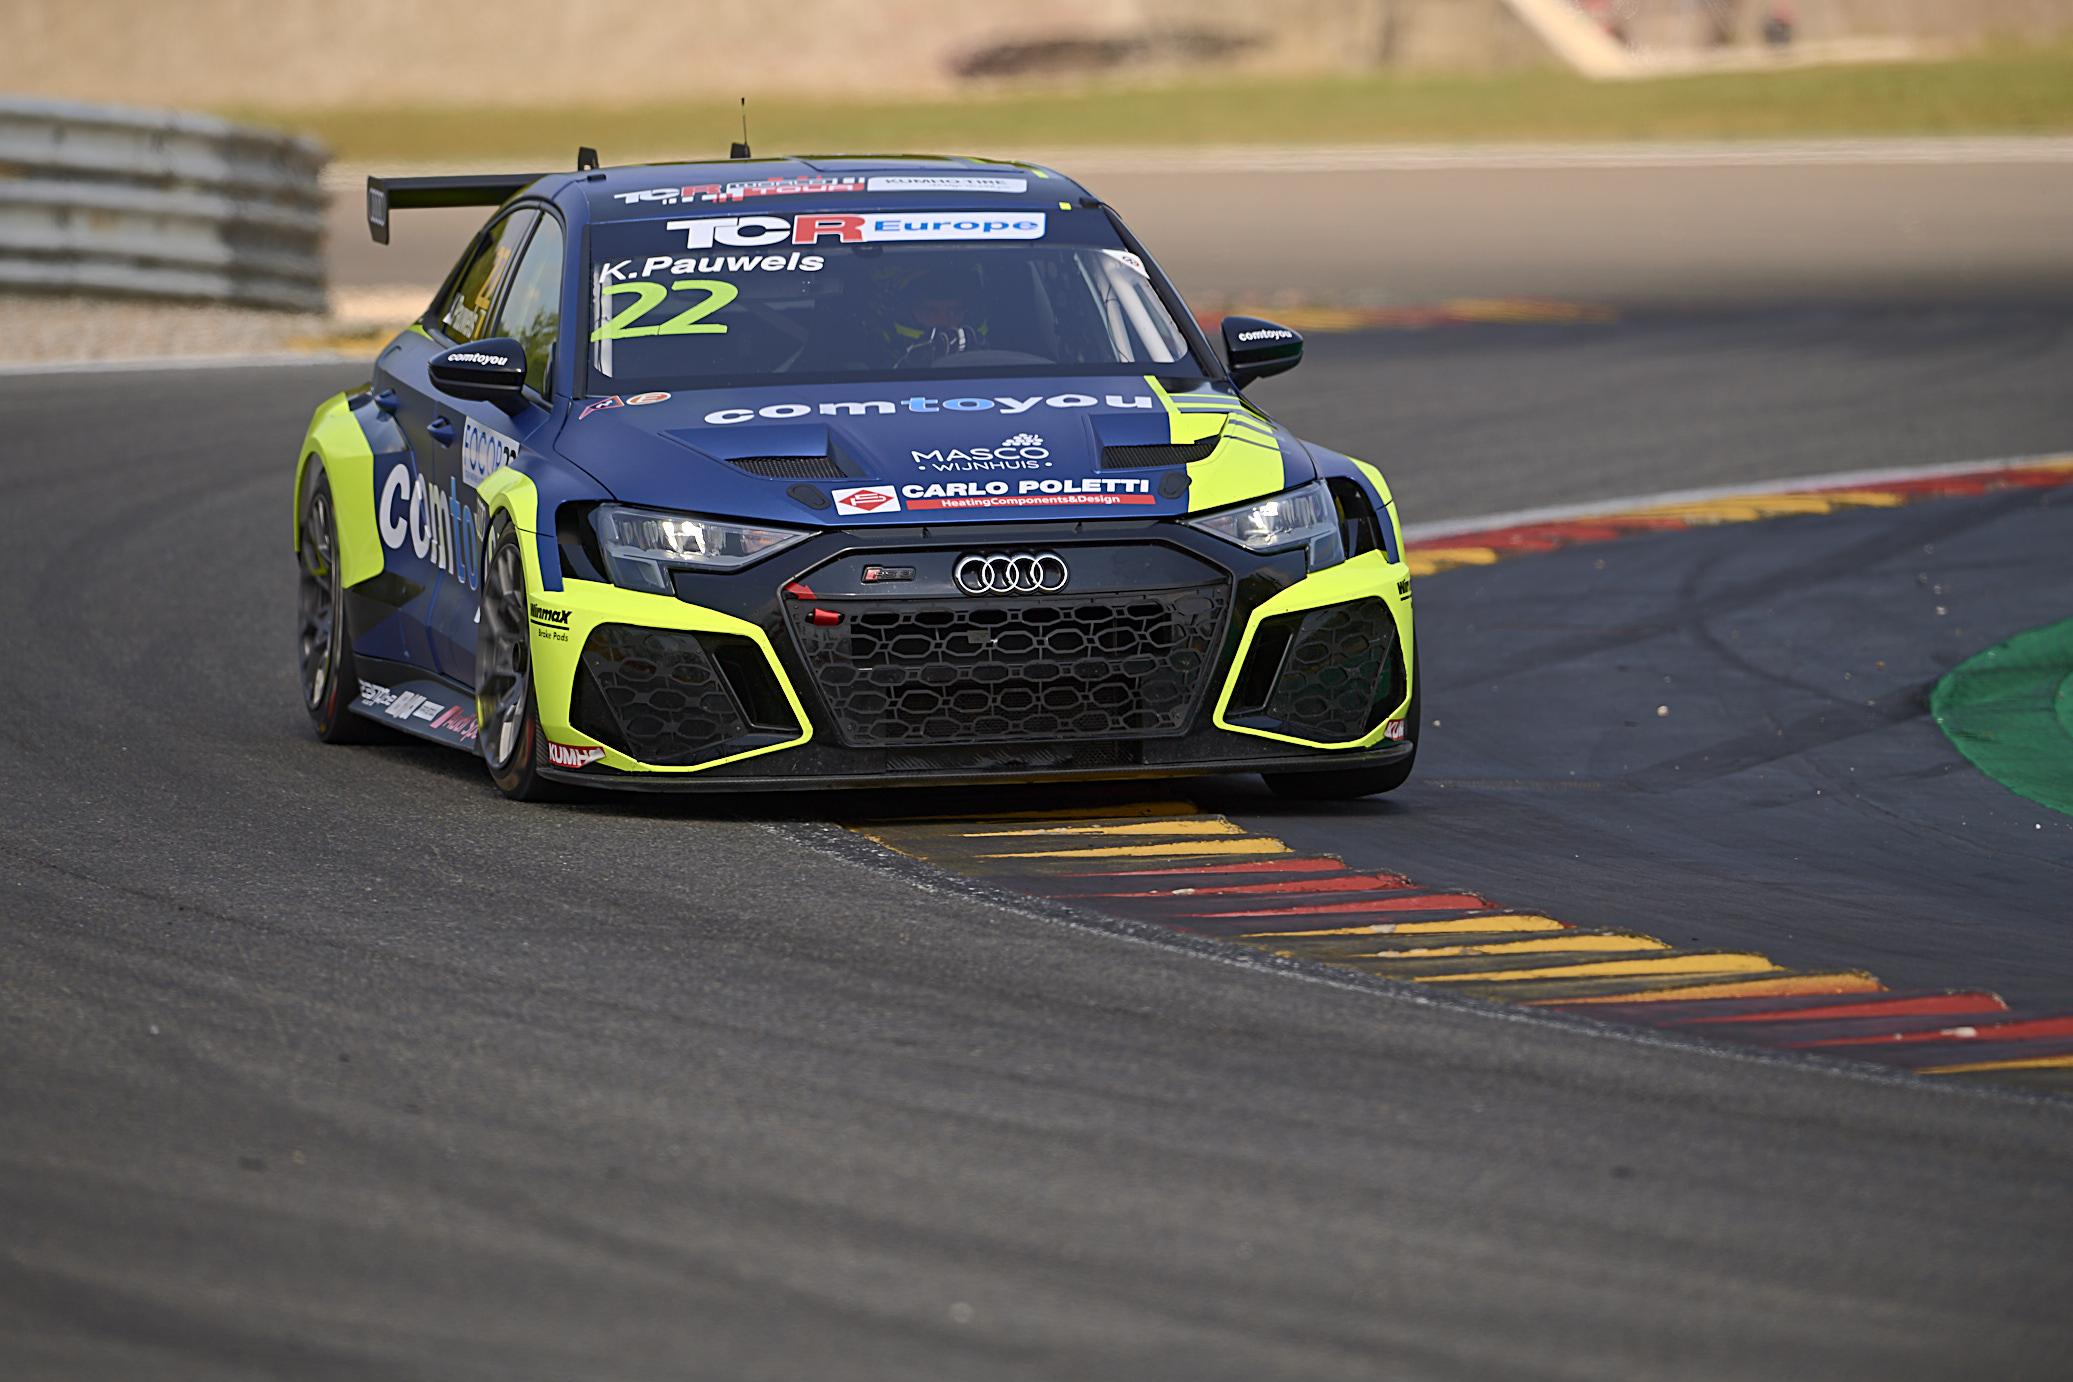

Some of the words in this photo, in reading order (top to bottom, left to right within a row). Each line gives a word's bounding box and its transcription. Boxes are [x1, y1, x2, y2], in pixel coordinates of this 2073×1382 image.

[666, 214, 866, 249] TCR
[874, 219, 1038, 233] Europe
[600, 251, 825, 283] K.Pauwels
[590, 279, 739, 342] 22
[1238, 329, 1293, 342] comtoyou
[447, 352, 508, 366] comtoyou
[704, 393, 1153, 425] comtoyou
[911, 446, 1050, 463] MASCO
[932, 460, 1040, 472] WIJNHUIS
[902, 481, 1009, 499] CARLO
[1018, 479, 1150, 495] POLETTI
[941, 494, 1121, 508] HeatingComponents&Design
[553, 631, 568, 642] Pads
